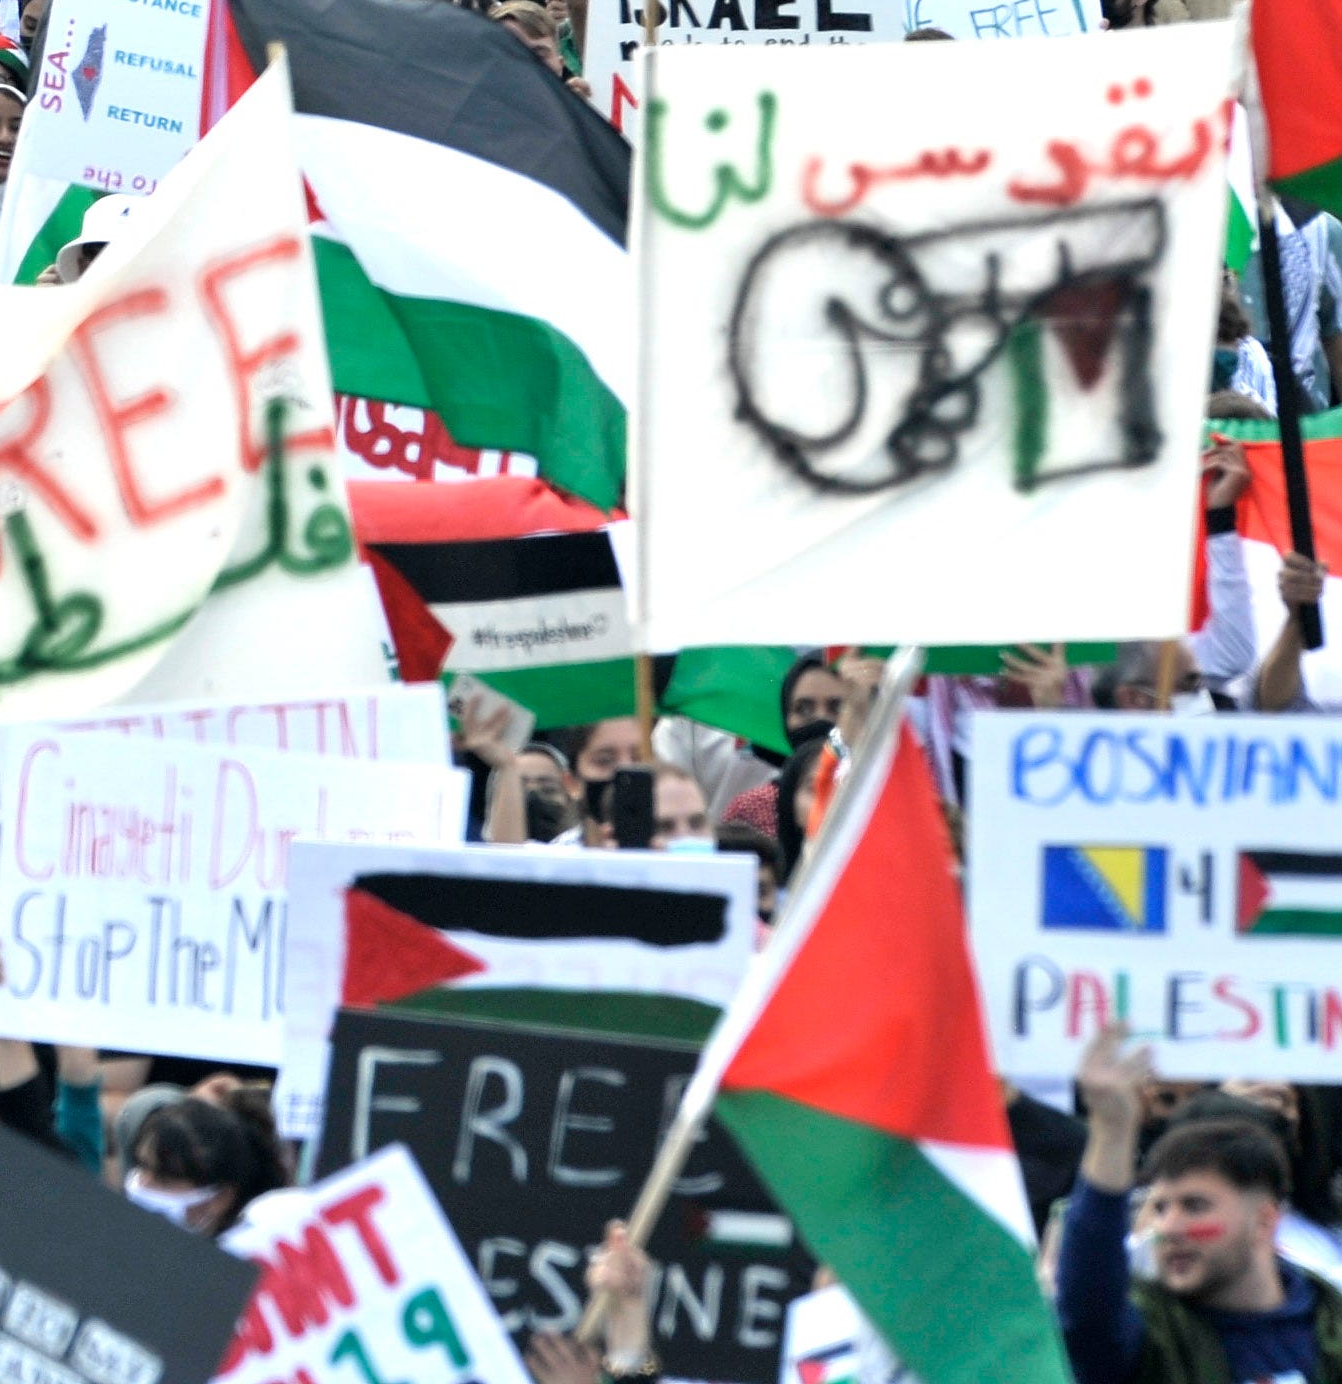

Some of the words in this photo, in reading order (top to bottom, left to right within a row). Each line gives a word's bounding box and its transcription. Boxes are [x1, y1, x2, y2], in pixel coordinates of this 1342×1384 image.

[114, 49, 198, 79] REFUSAL
[106, 104, 184, 134] RETURN
[1178, 849, 1215, 927] 4
